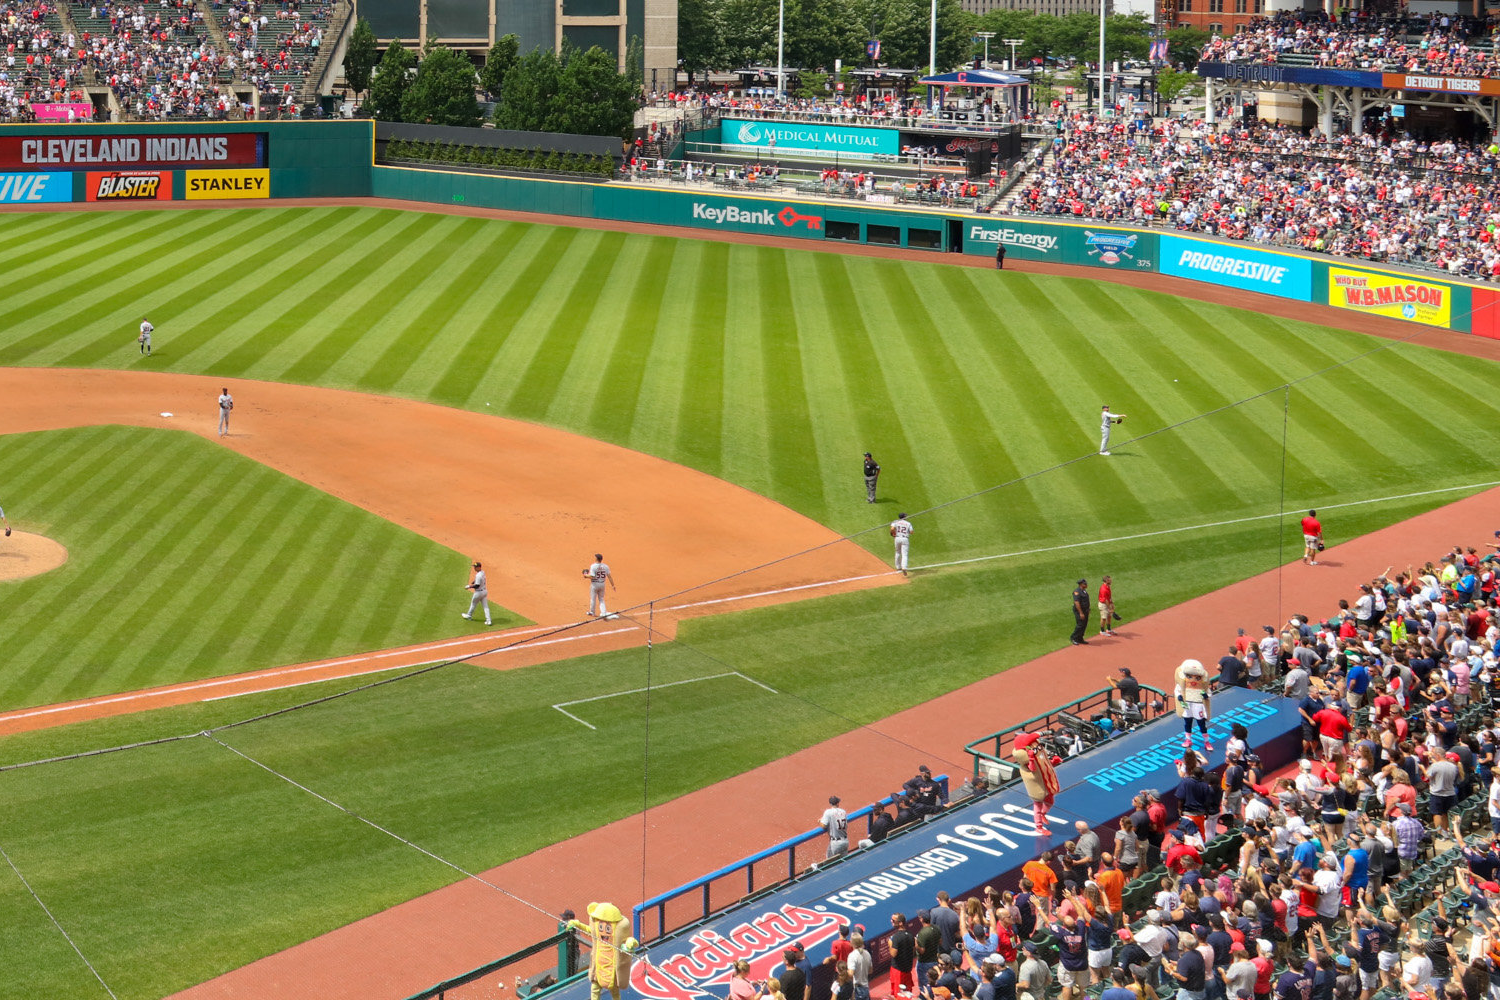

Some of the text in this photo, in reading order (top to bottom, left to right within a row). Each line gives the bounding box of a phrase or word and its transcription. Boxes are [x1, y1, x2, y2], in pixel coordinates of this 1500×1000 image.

[957, 72, 967, 83] C
[1405, 75, 1480, 91] DETROIT TIGERS
[764, 128, 879, 146] MEDICAL MUTUAL
[22, 137, 228, 163] CLEVELAND INDIANS
[98, 176, 159, 198] BLASTER
[190, 177, 264, 191] STANLEY
[693, 203, 775, 227] KeyBank
[970, 226, 1057, 248] FirstEnergy
[1091, 236, 1131, 245] PROGRESSIVE
[1179, 249, 1286, 284] PROGRESSIVE
[1335, 276, 1367, 286] WHO BUT
[897, 526, 907, 534] 12
[596, 570, 606, 579] 55
[836, 819, 846, 830] 17
[630, 803, 1068, 1000] Indians ESTABLISHED 1901
